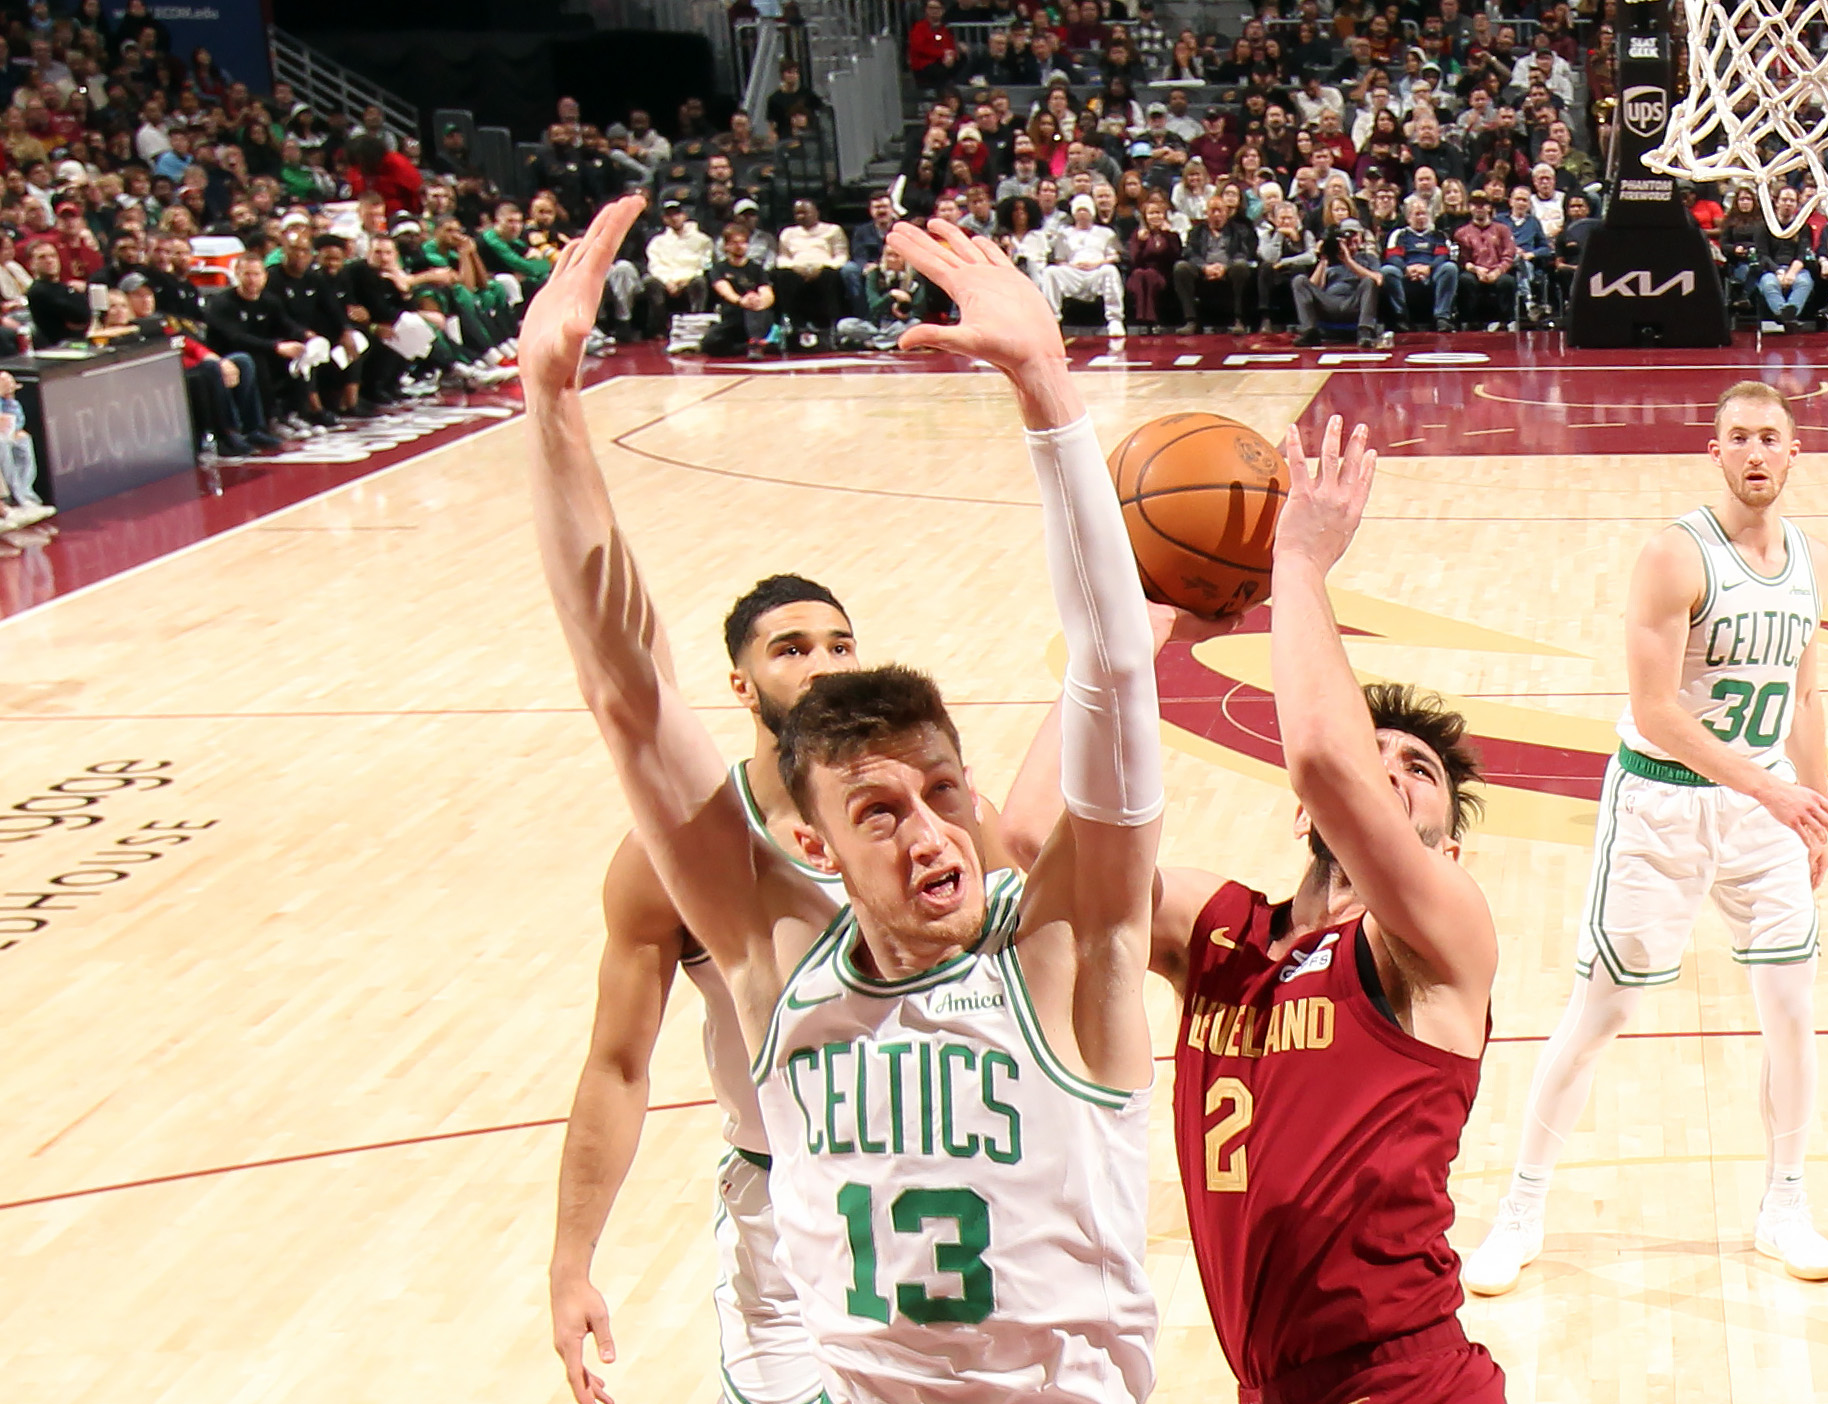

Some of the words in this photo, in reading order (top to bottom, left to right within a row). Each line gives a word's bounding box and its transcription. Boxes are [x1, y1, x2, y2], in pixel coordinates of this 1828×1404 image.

[1628, 102, 1663, 129] ups
[1590, 270, 1695, 298] KIA
[1701, 678, 1790, 748] 30
[935, 991, 1004, 1014] Amica
[1187, 995, 1336, 1058] LEVELAND
[787, 1041, 1022, 1165] CELTICS
[1204, 1076, 1253, 1193] 2
[837, 1183, 995, 1325] 13
